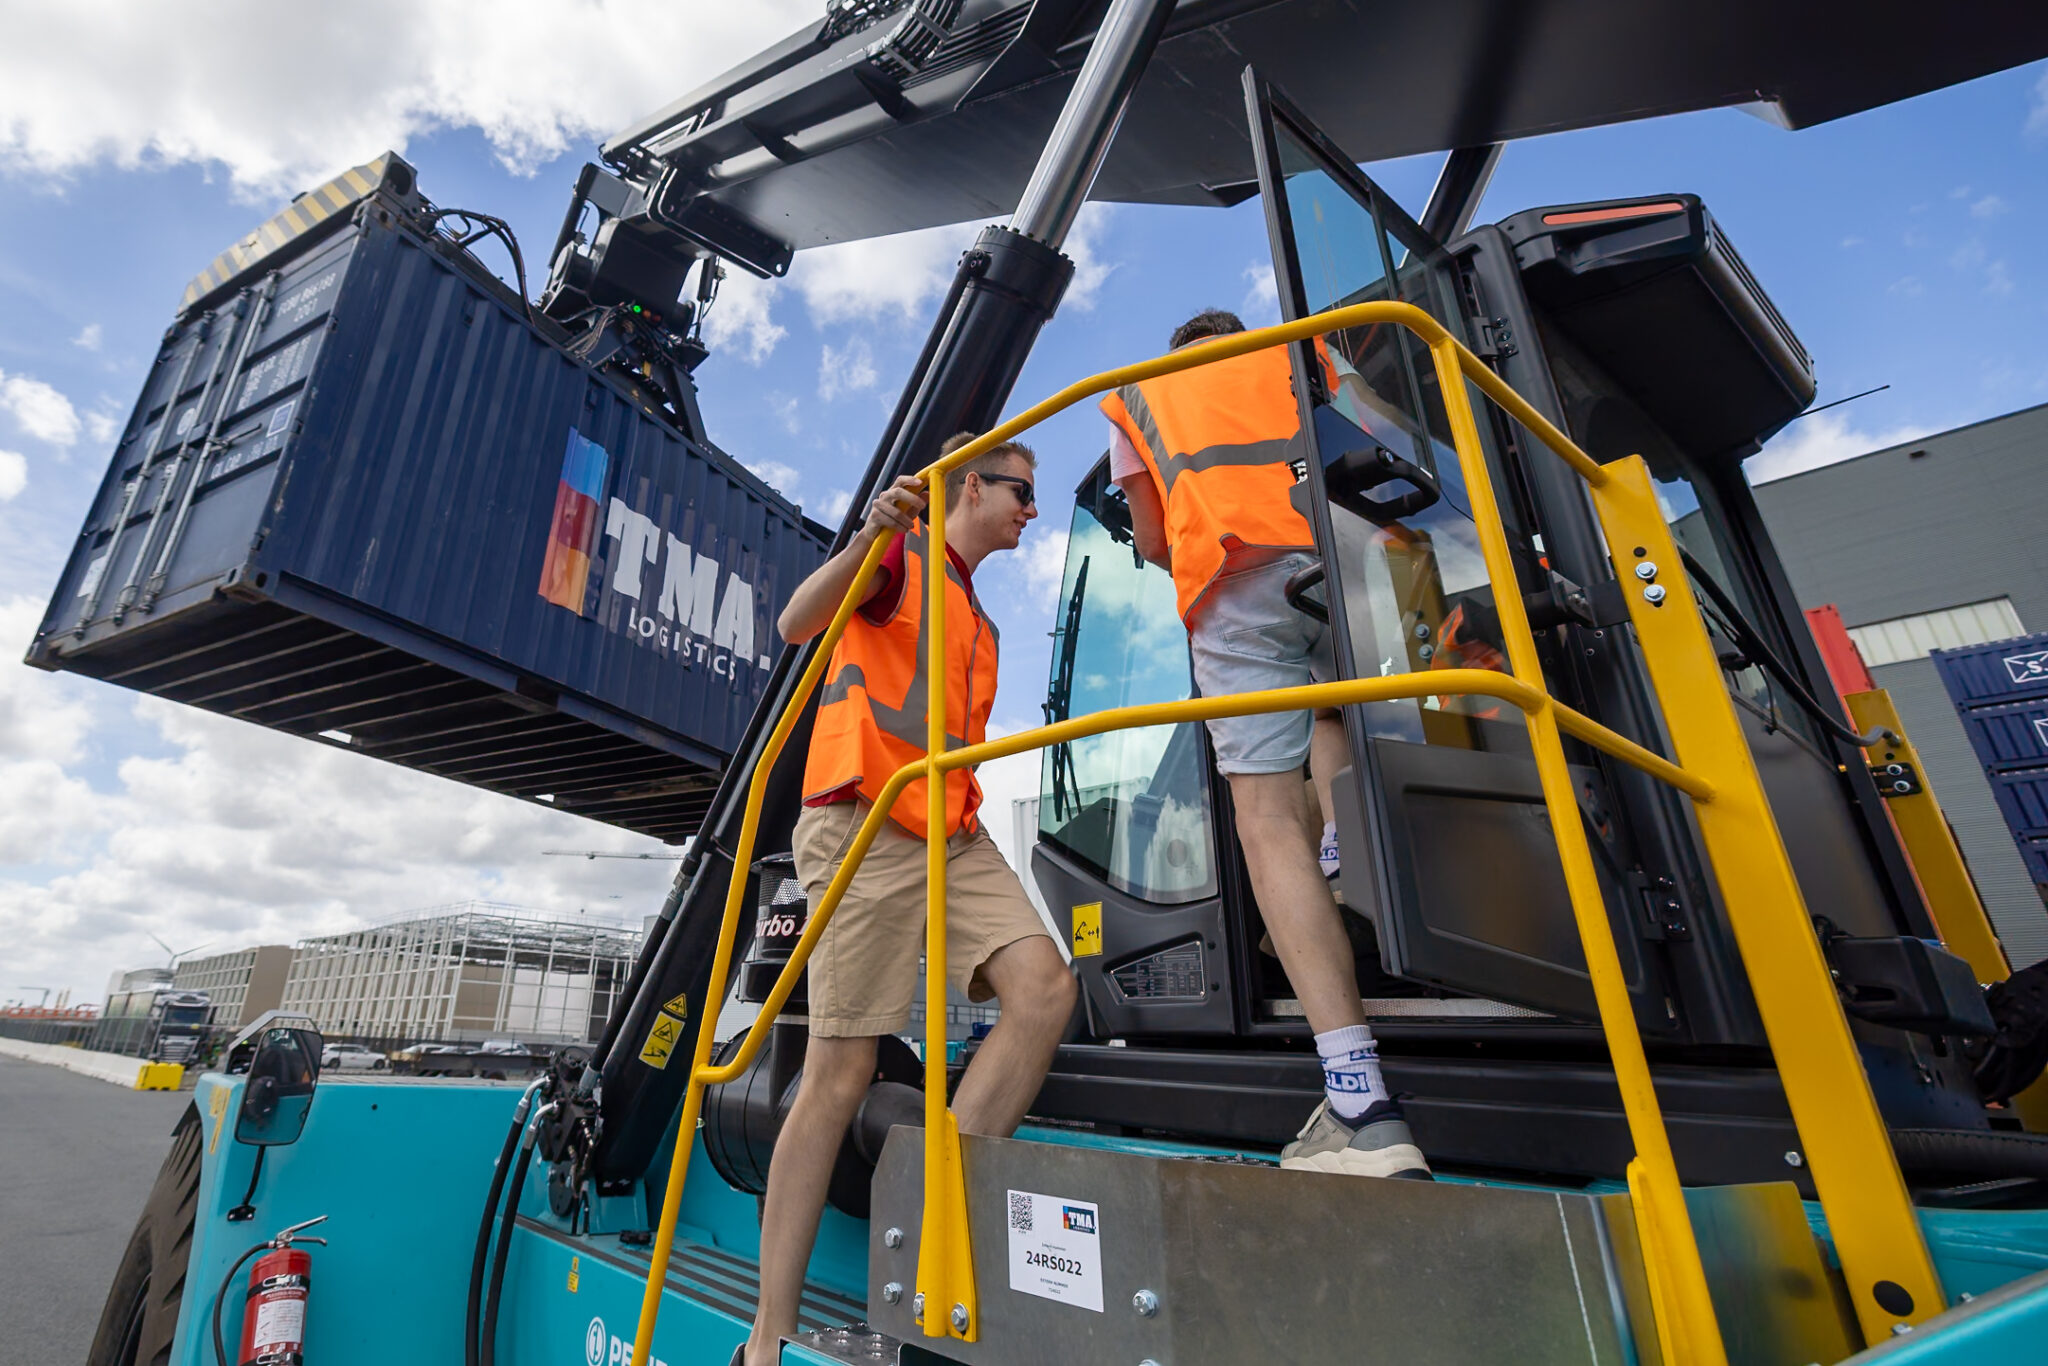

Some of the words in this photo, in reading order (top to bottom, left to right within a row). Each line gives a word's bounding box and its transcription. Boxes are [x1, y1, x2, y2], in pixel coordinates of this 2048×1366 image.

[605, 497, 770, 671] TMA.
[629, 606, 736, 680] LOGISTICS
[1026, 1250, 1082, 1276] 24RS022
